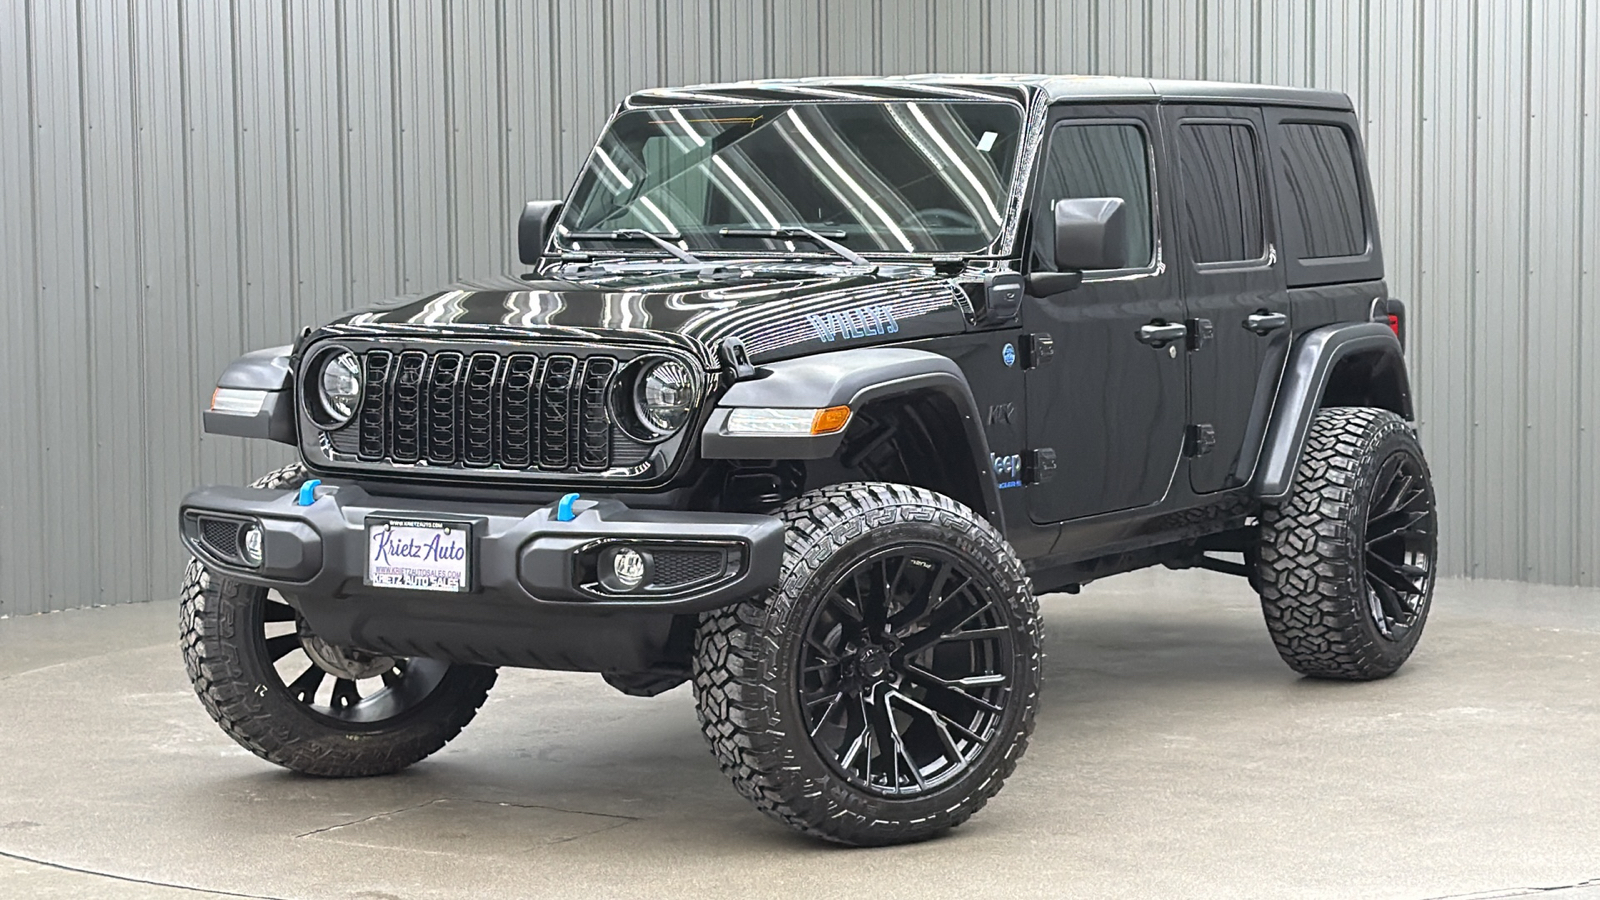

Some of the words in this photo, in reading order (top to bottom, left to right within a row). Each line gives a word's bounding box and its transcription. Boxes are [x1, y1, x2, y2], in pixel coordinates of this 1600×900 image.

[807, 306, 898, 342] WILLYS
[373, 530, 421, 566] Krietz
[423, 533, 465, 562] Auto
[373, 573, 404, 585] KRIETZ
[405, 575, 429, 587] AUTO
[432, 576, 459, 590] SALES
[375, 566, 461, 577] WWW.KRIETZAUTOSALES.COM
